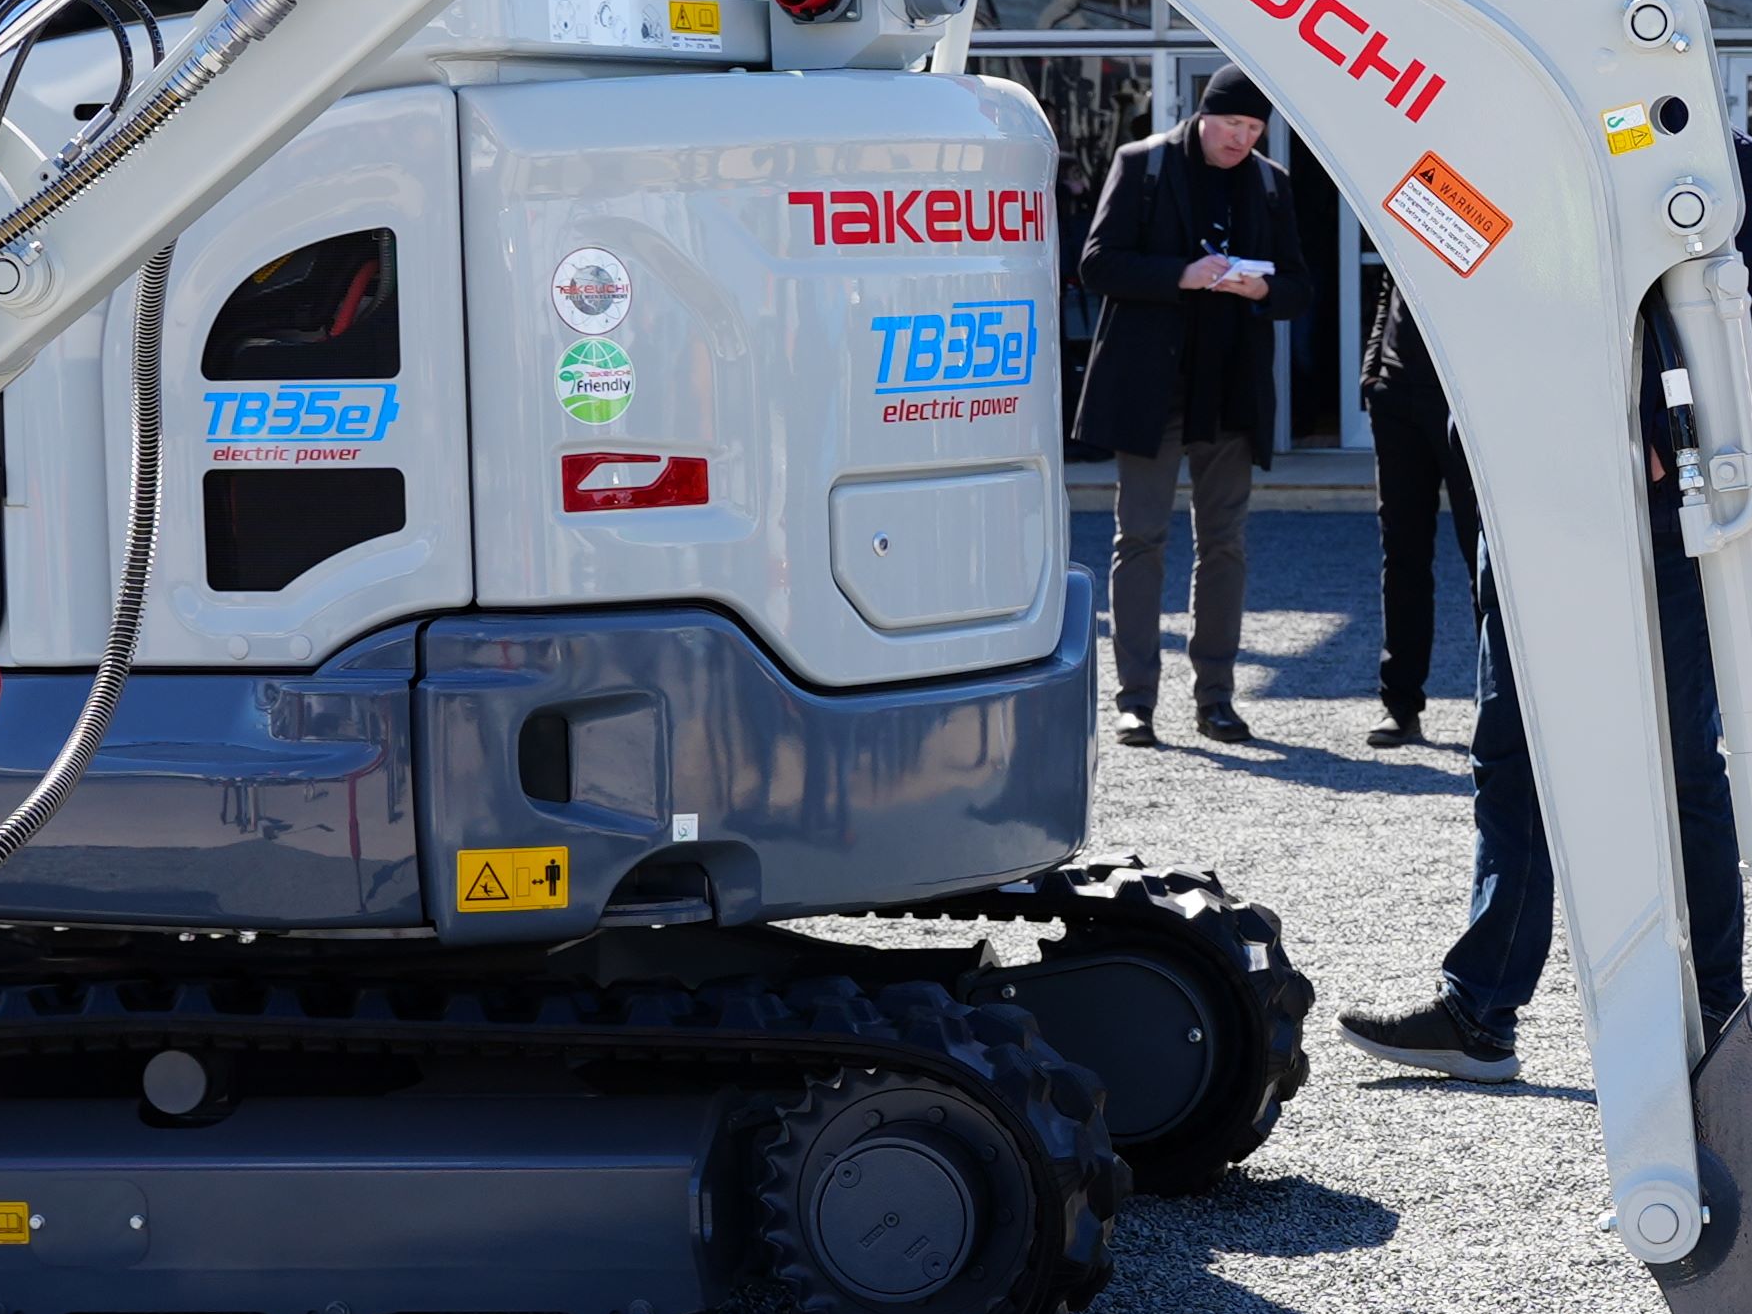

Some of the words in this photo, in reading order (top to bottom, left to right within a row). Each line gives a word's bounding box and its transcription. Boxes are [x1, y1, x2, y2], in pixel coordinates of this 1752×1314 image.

[788, 189, 1044, 245] TAKEUCHI
[1439, 182, 1494, 233] WARNING
[871, 312, 1023, 384] TB35e
[203, 391, 372, 435] TB35e
[883, 396, 964, 424] electric
[969, 396, 1019, 423] power
[213, 445, 291, 461] electric
[295, 447, 361, 465] power
